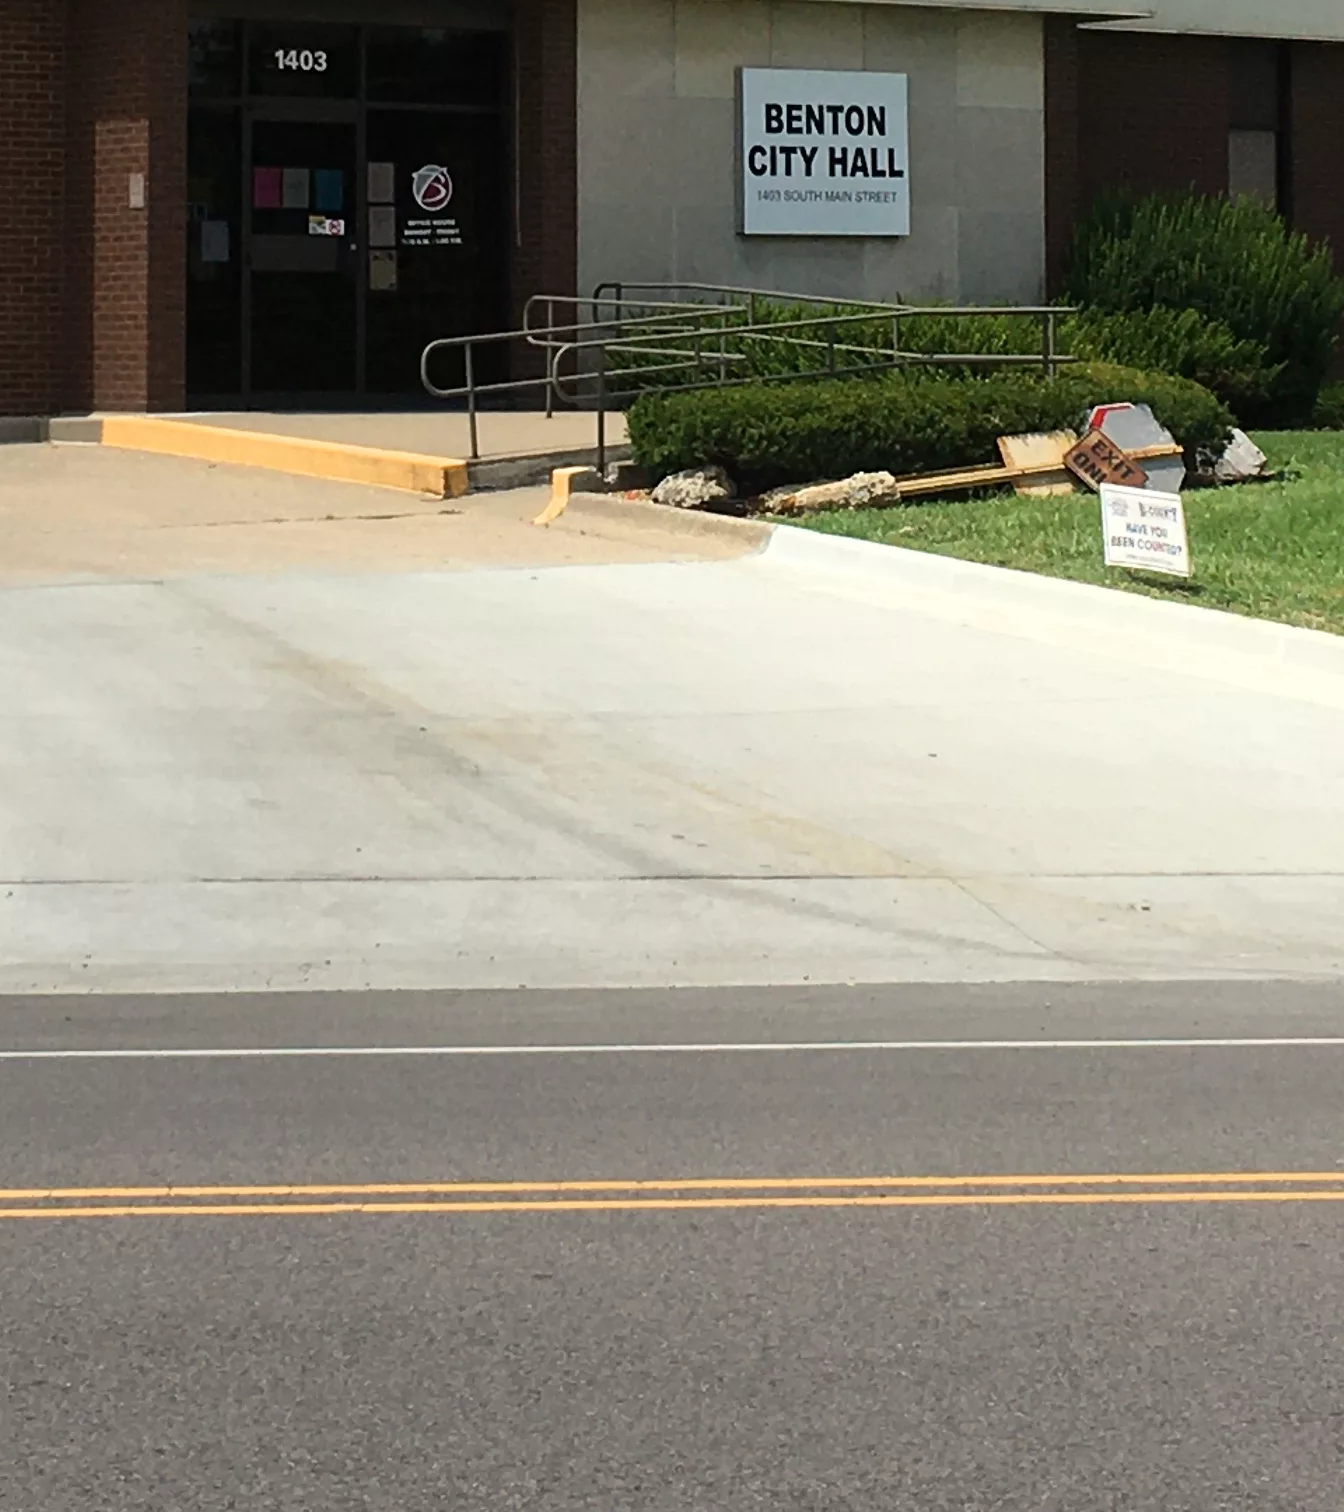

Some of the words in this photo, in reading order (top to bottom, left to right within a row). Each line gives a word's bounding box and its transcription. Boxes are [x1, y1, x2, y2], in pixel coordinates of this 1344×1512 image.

[274, 49, 328, 72] 1403
[765, 103, 886, 136] BENTON
[748, 145, 818, 177] CITY
[828, 146, 904, 178] HALL
[757, 190, 782, 202] 1403
[783, 190, 822, 202] SOUTH
[825, 191, 852, 203] MAIN
[855, 191, 897, 203] STREET
[1091, 439, 1135, 479] EXIT
[1111, 535, 1135, 548] BEEN
[1150, 525, 1168, 538] YOU
